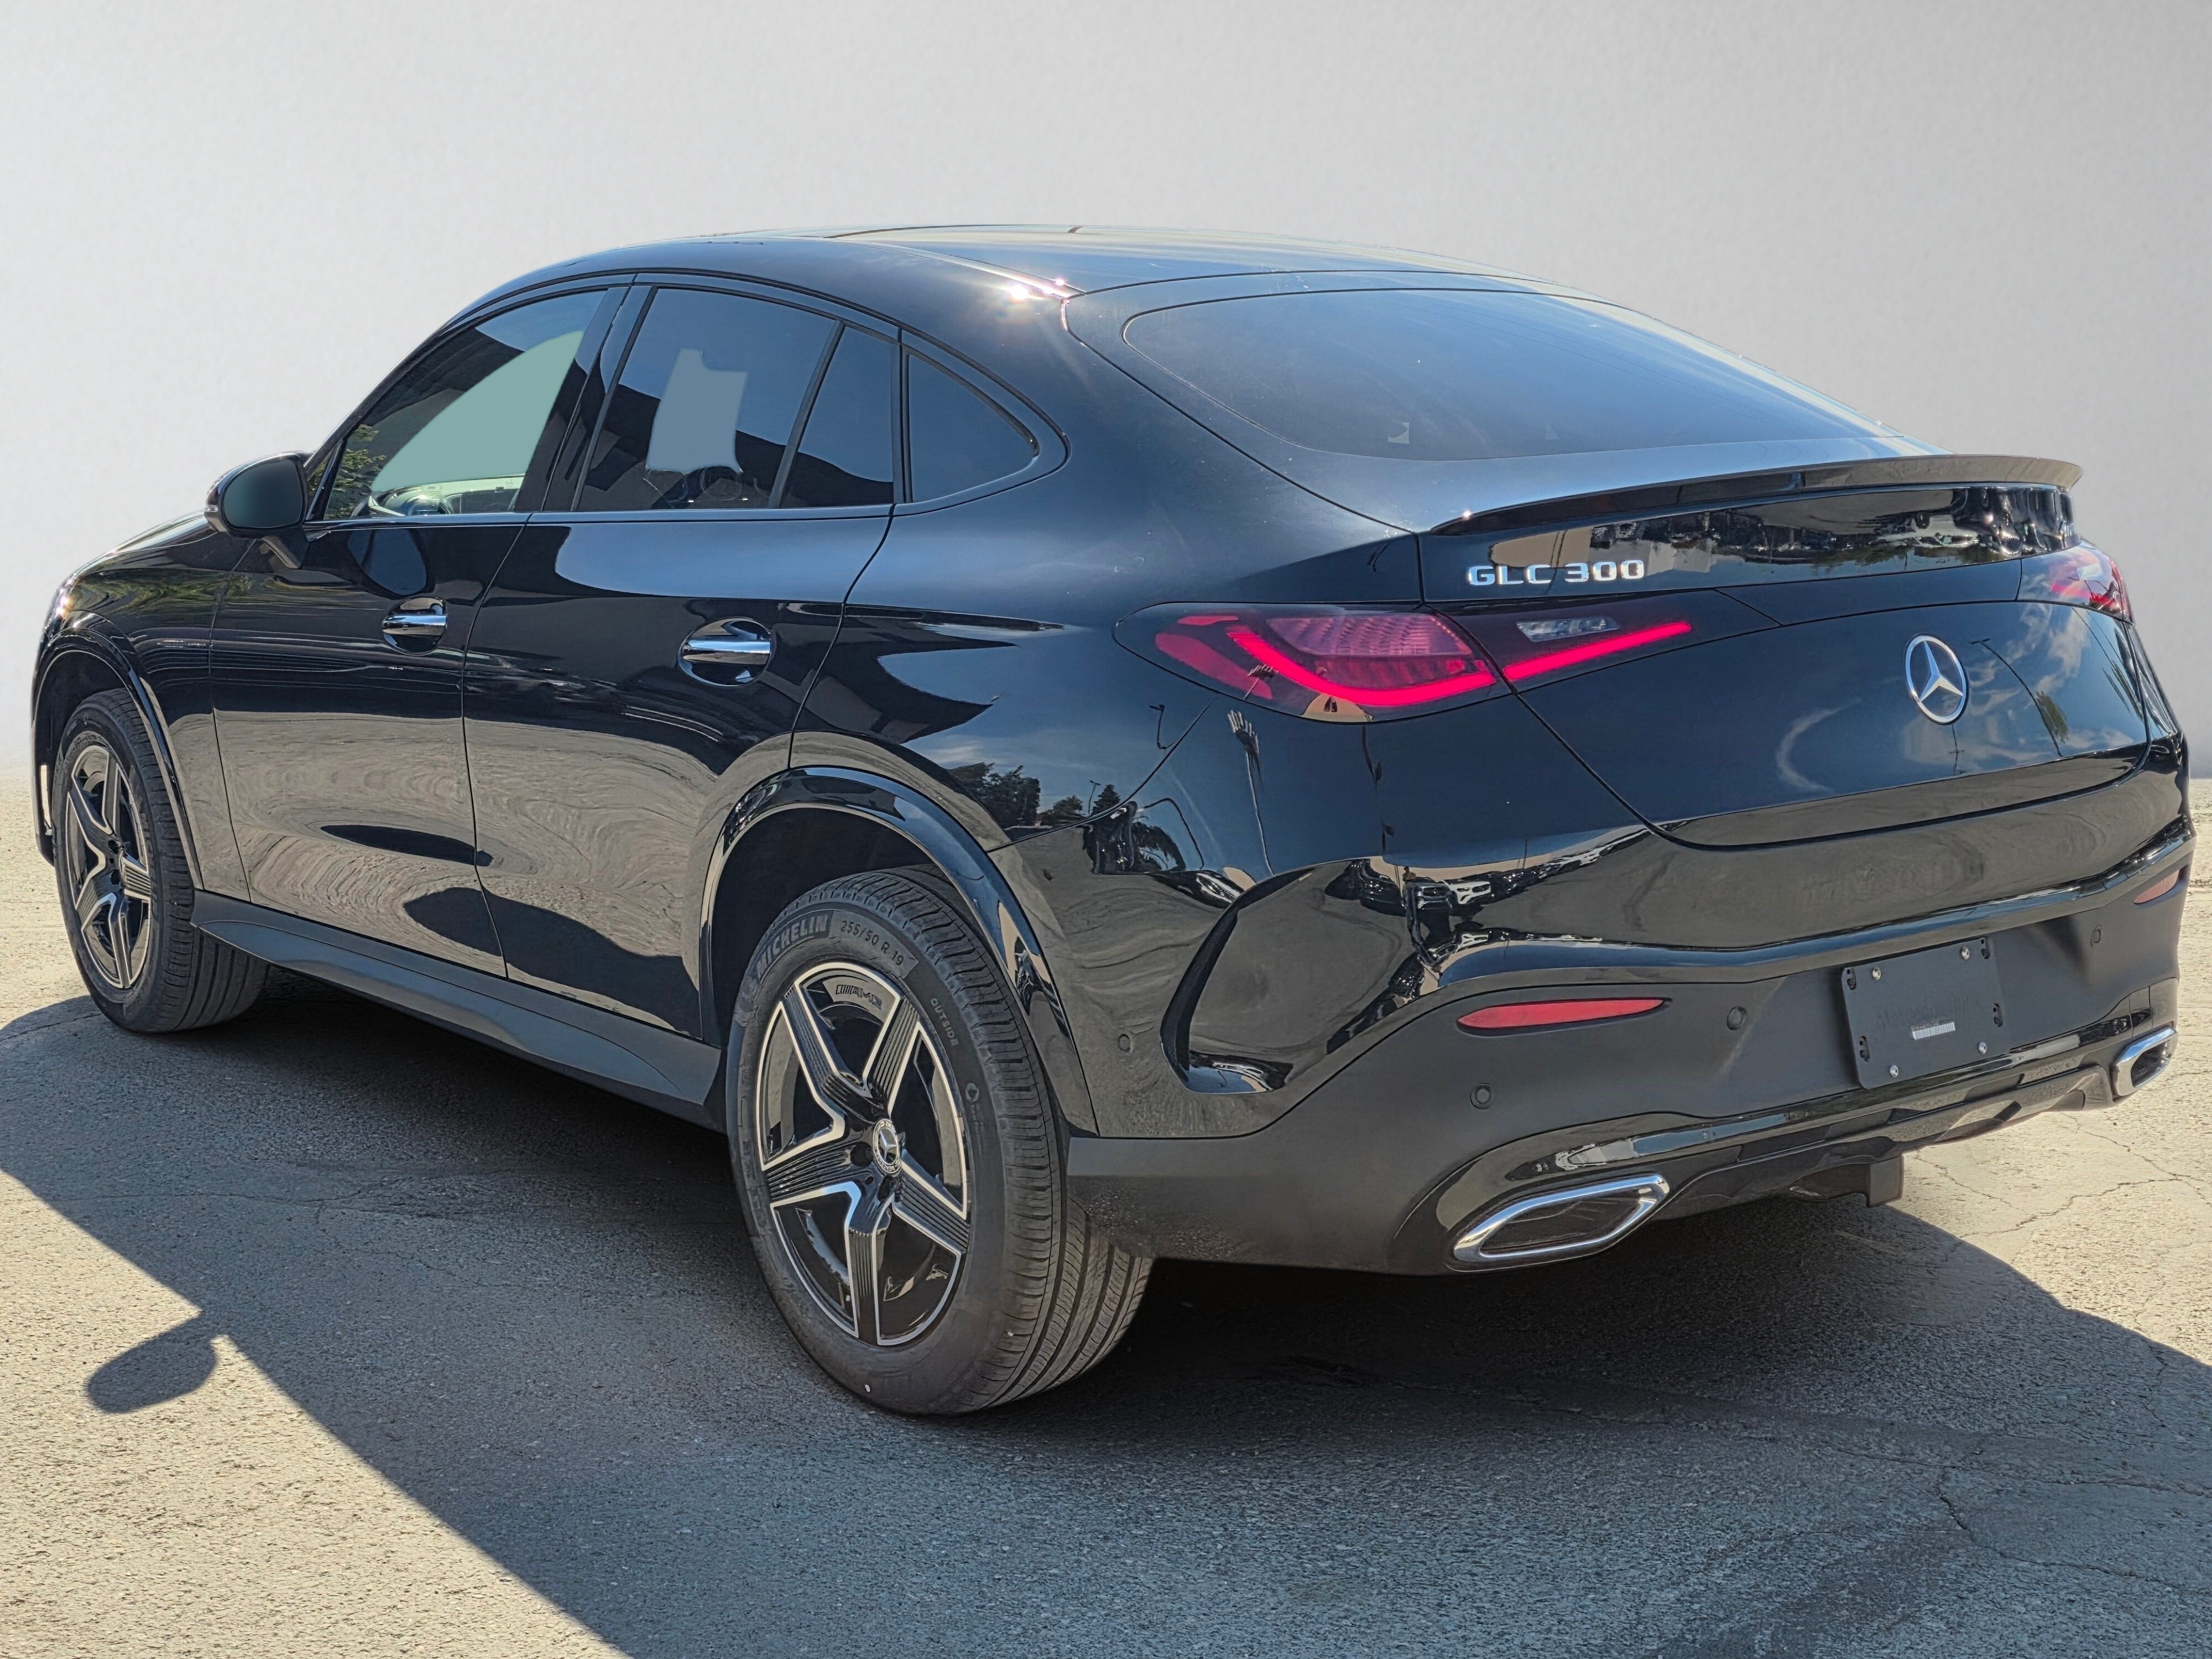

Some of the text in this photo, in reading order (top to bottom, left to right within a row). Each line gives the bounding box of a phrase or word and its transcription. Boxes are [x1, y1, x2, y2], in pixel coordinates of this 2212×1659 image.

[1468, 559, 1645, 586] GLC 300
[756, 914, 829, 977] MICHELIN
[840, 920, 904, 966] 255/50 R 19
